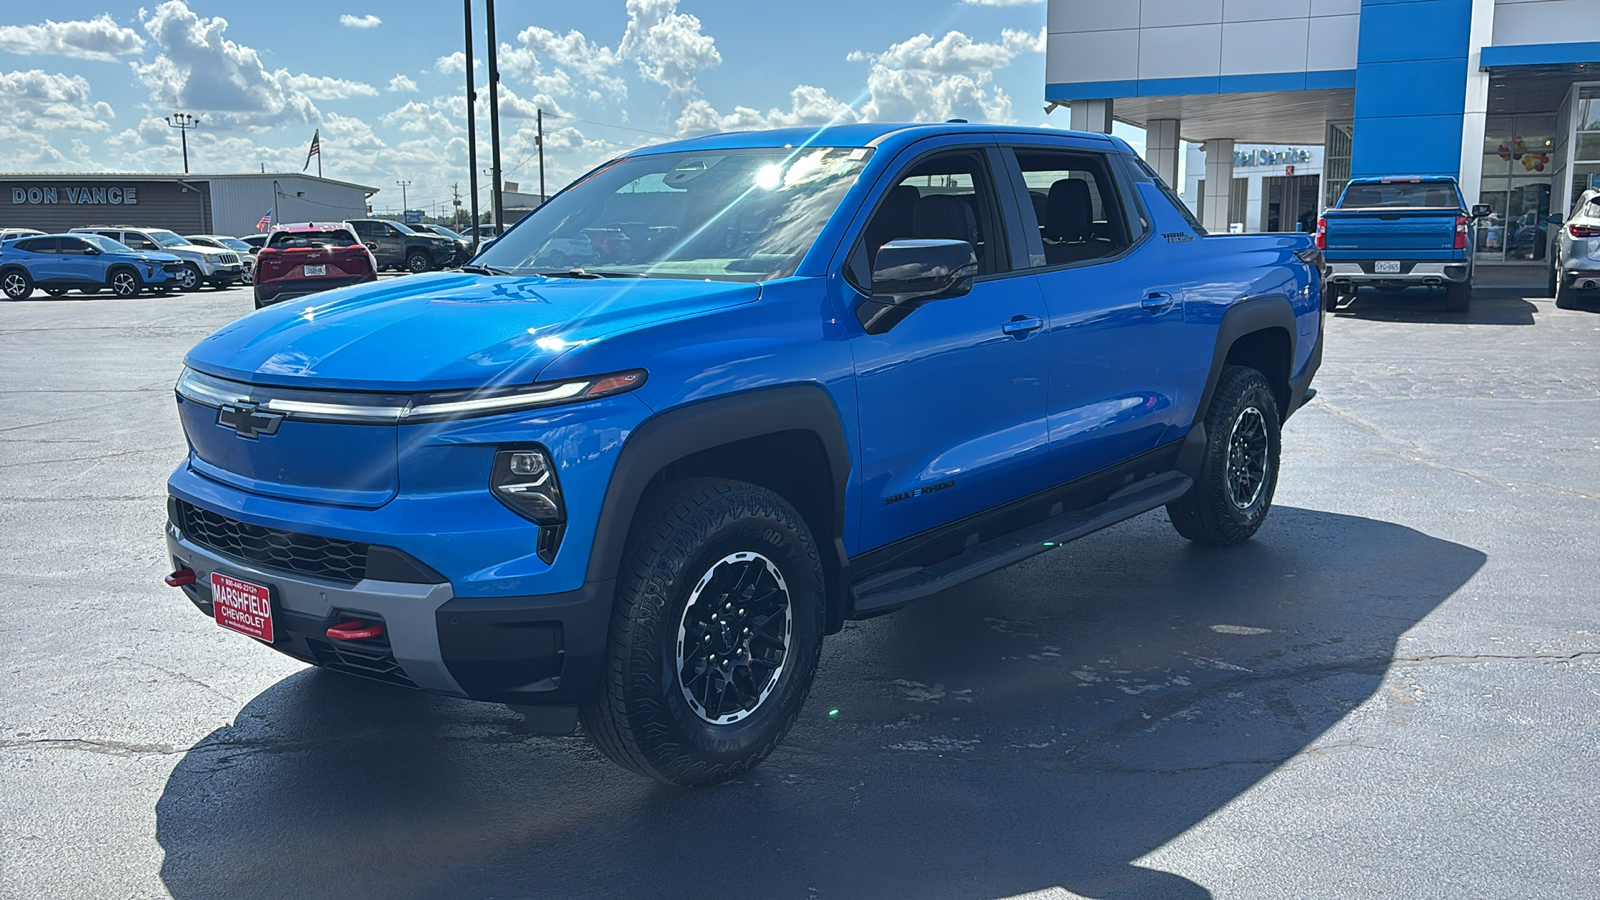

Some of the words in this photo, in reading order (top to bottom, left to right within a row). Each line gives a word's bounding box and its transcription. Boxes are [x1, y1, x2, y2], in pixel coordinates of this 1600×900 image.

[1260, 147, 1309, 166] Service
[12, 187, 58, 204] DON
[66, 187, 137, 204] VANCE
[885, 480, 956, 505] SILVERADO
[213, 583, 270, 618] MARSHFIELD
[221, 606, 265, 628] CHEVROLET
